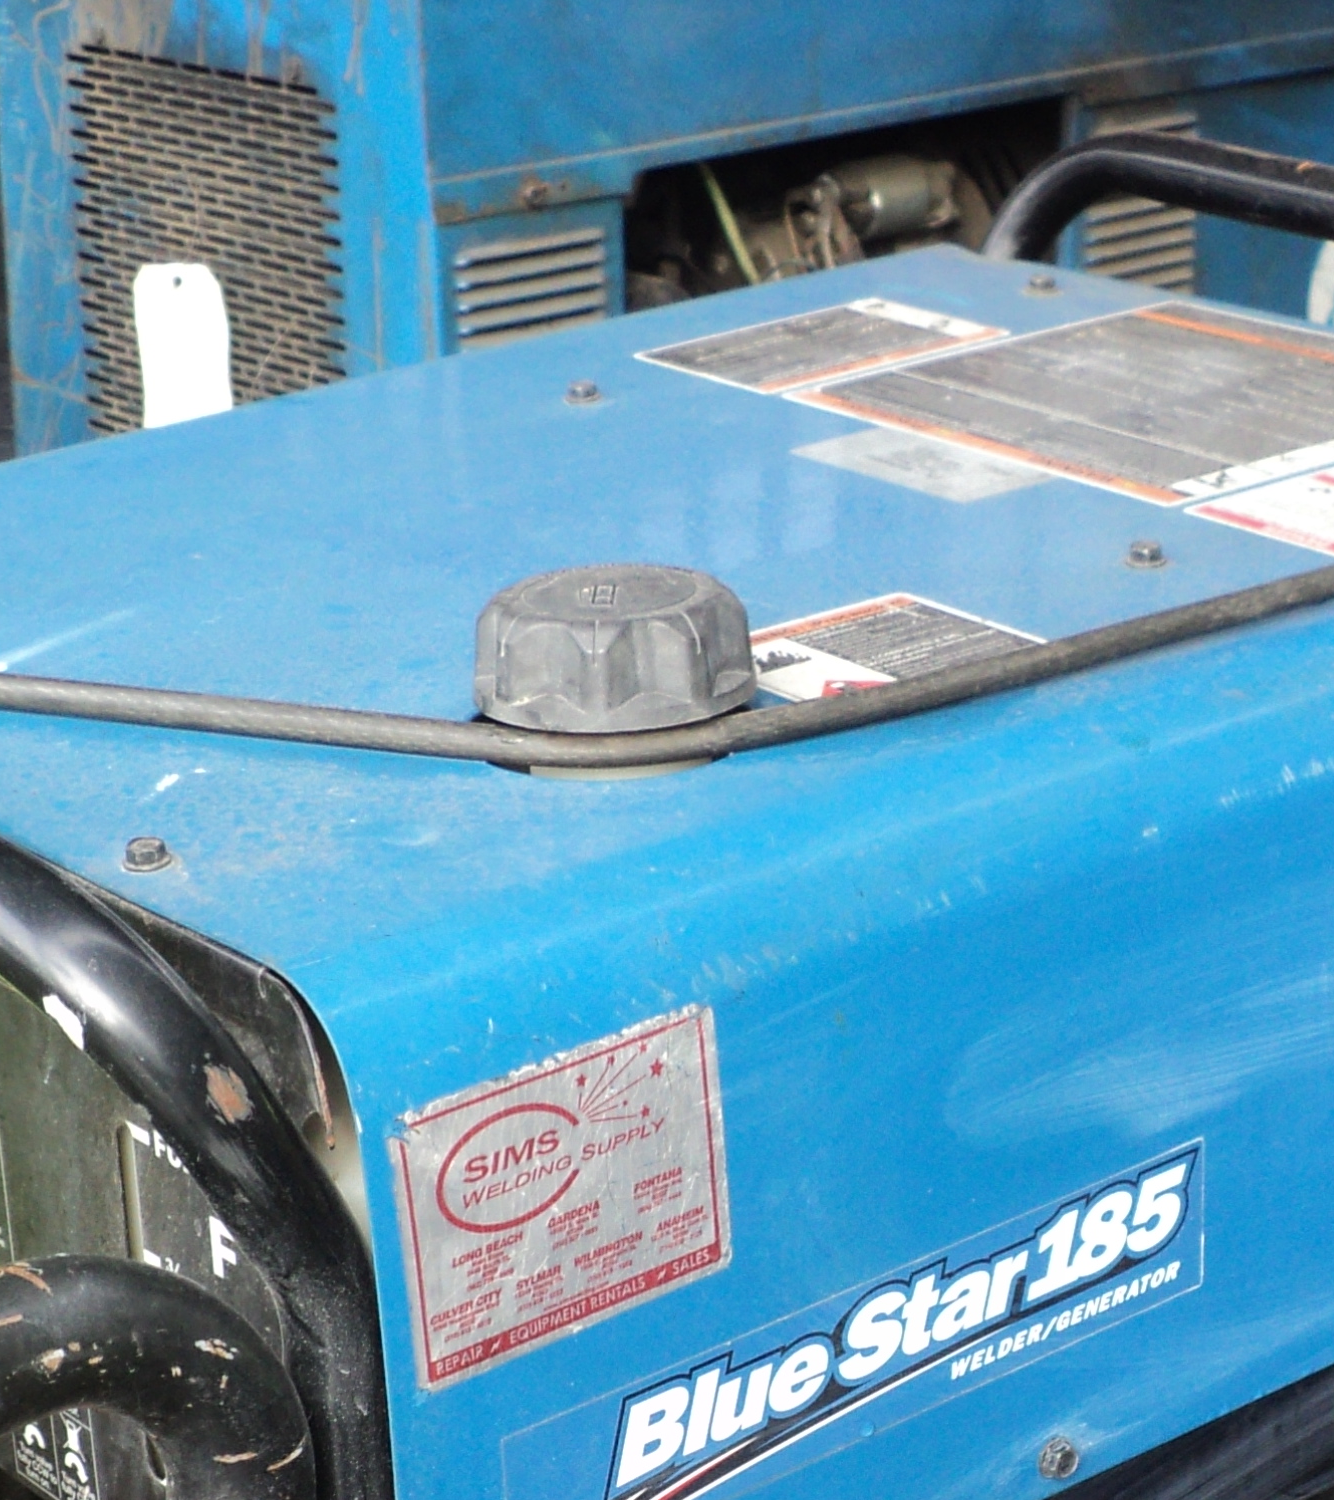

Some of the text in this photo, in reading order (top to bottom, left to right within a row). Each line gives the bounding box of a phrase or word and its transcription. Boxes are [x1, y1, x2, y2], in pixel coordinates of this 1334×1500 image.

[462, 1117, 666, 1210] WELDING SUPPLY
[463, 1129, 560, 1184] SIMS
[634, 1167, 683, 1194] FONTANA
[548, 1200, 600, 1229] GARDENA
[655, 1205, 704, 1233] ANAHEIM
[452, 1231, 524, 1269] LONG BEACH
[436, 1345, 484, 1376] REPAIR
[509, 1301, 587, 1344] EQUIPMENT
[590, 1276, 646, 1310] RENTALS
[671, 1249, 711, 1276] SALES
[616, 1162, 1187, 1488] Blue Star 185
[950, 1260, 1182, 1381] WELDER/GENERATOR
